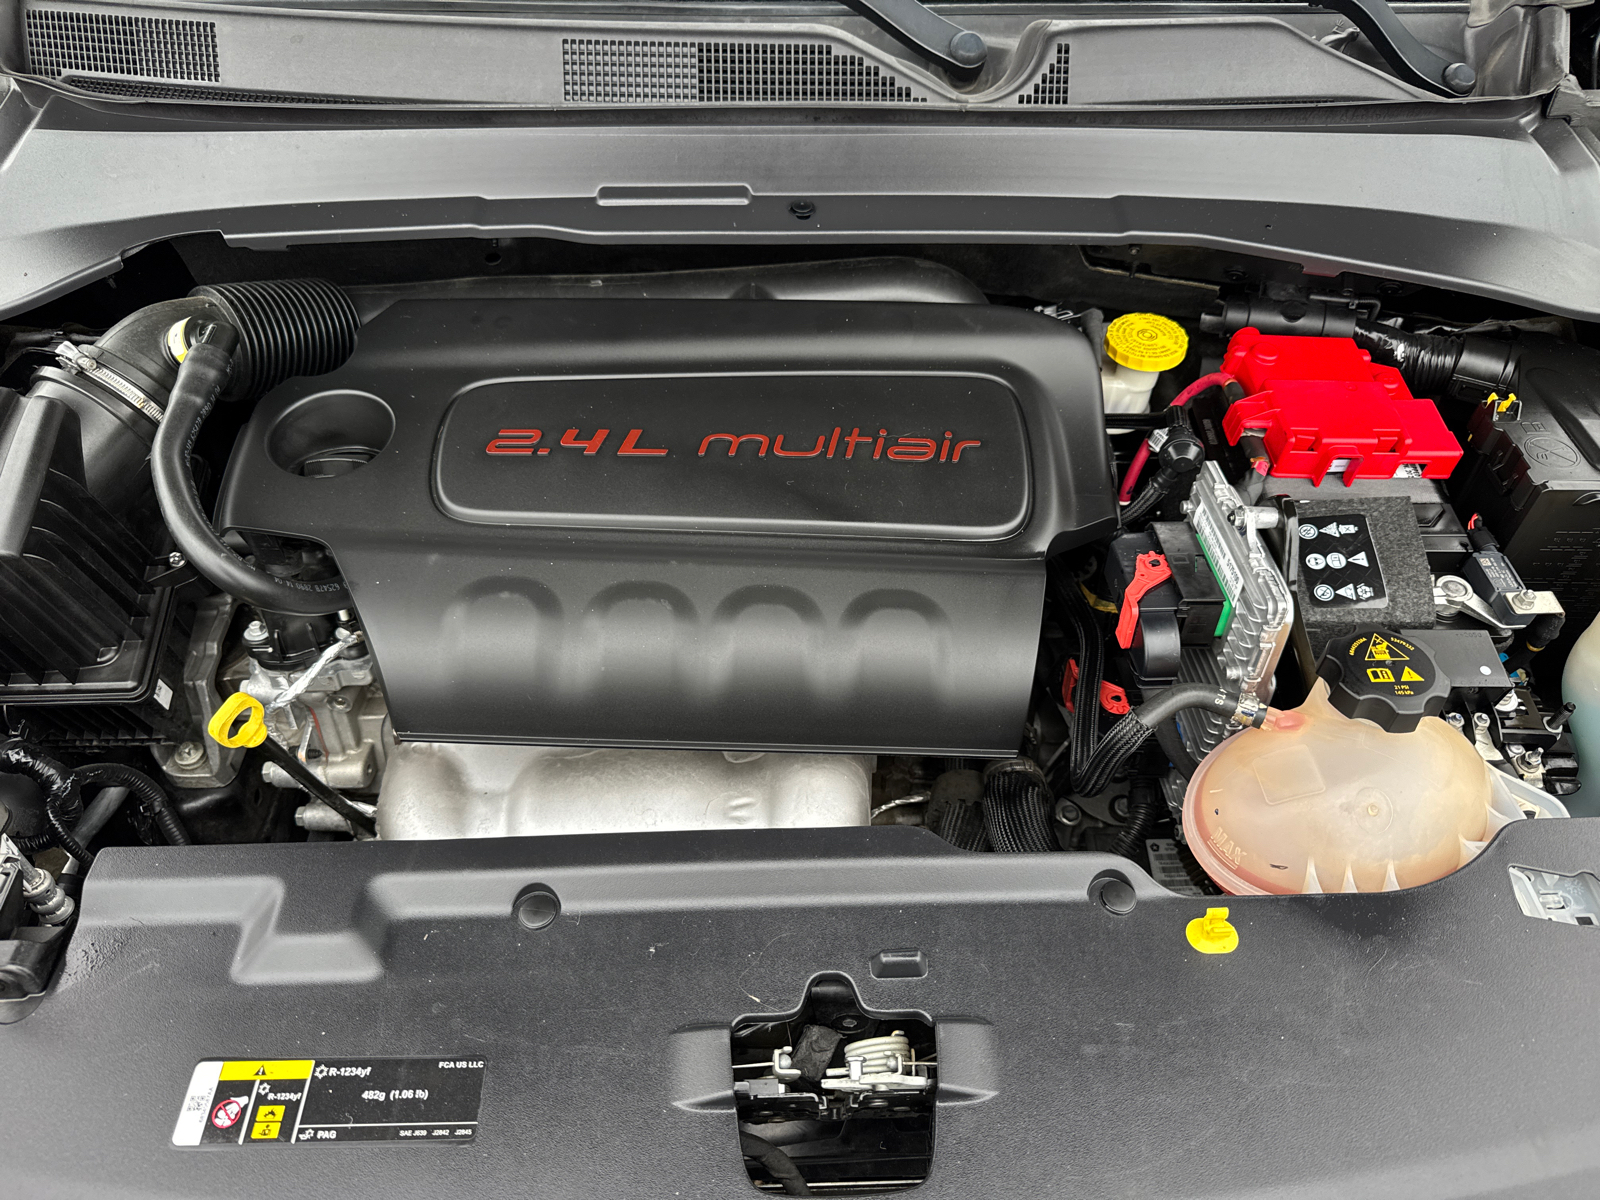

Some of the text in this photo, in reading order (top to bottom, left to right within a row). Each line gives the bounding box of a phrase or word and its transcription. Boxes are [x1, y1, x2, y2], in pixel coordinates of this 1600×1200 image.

[698, 427, 981, 463] multiair
[1210, 826, 1248, 866] MAX
[438, 1060, 485, 1069] FCA US LLC
[328, 1066, 372, 1078] R-1234yf
[267, 1092, 302, 1102] R-1234yf
[361, 1088, 429, 1102] 482g (1.06 lb)
[316, 1130, 337, 1139] PAG
